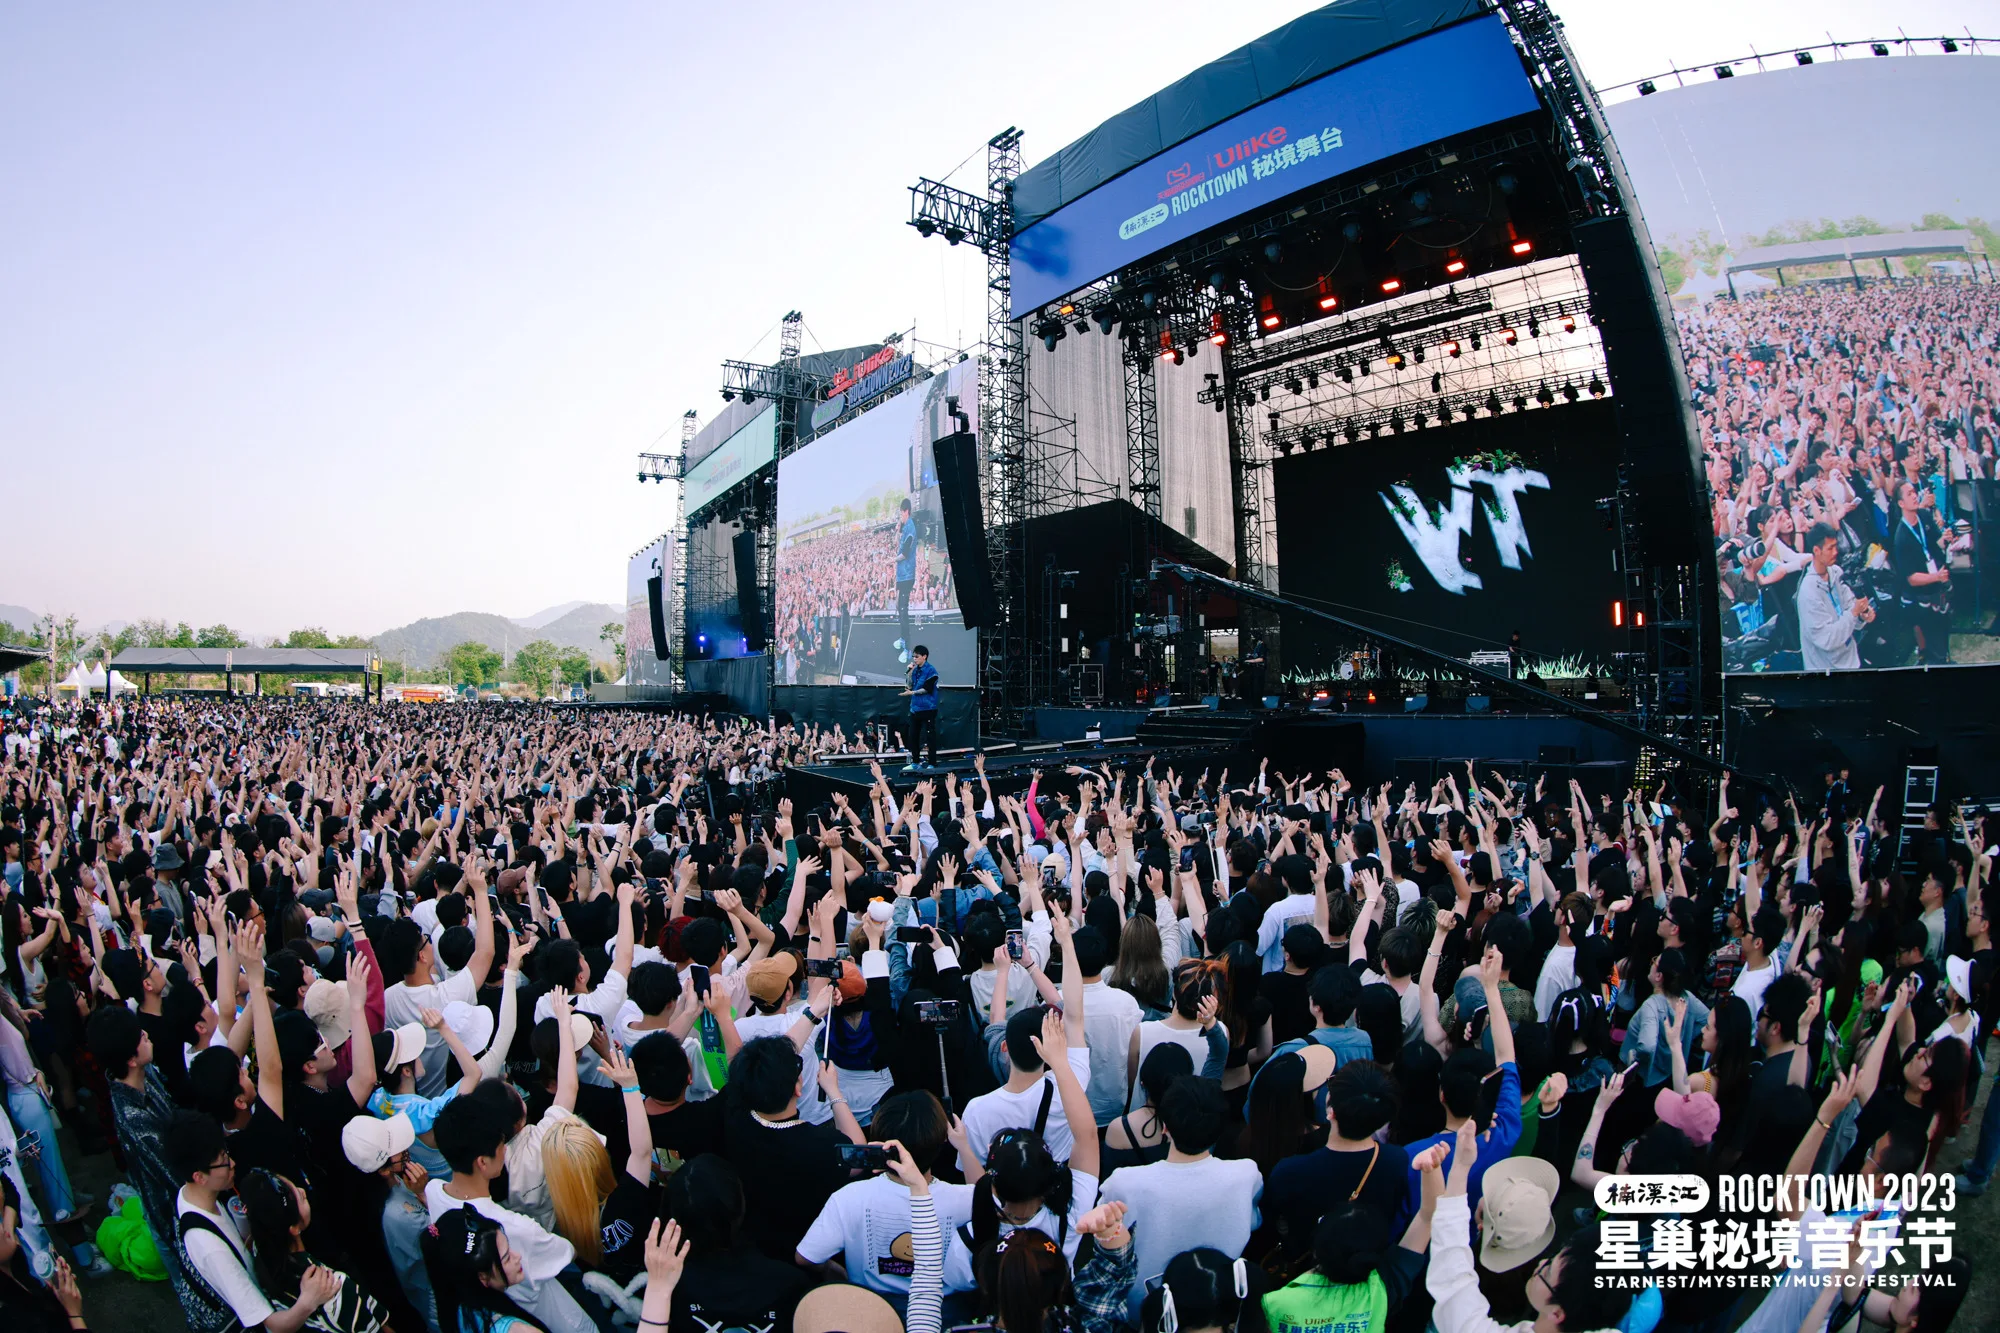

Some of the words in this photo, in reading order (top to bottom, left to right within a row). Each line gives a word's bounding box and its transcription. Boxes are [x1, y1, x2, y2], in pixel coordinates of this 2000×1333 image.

[1214, 126, 1287, 169] Ulike
[1171, 164, 1249, 217] ROCKTOWN
[1251, 127, 1343, 181] 秘境舞台
[1304, 1316, 1335, 1325] Ulike
